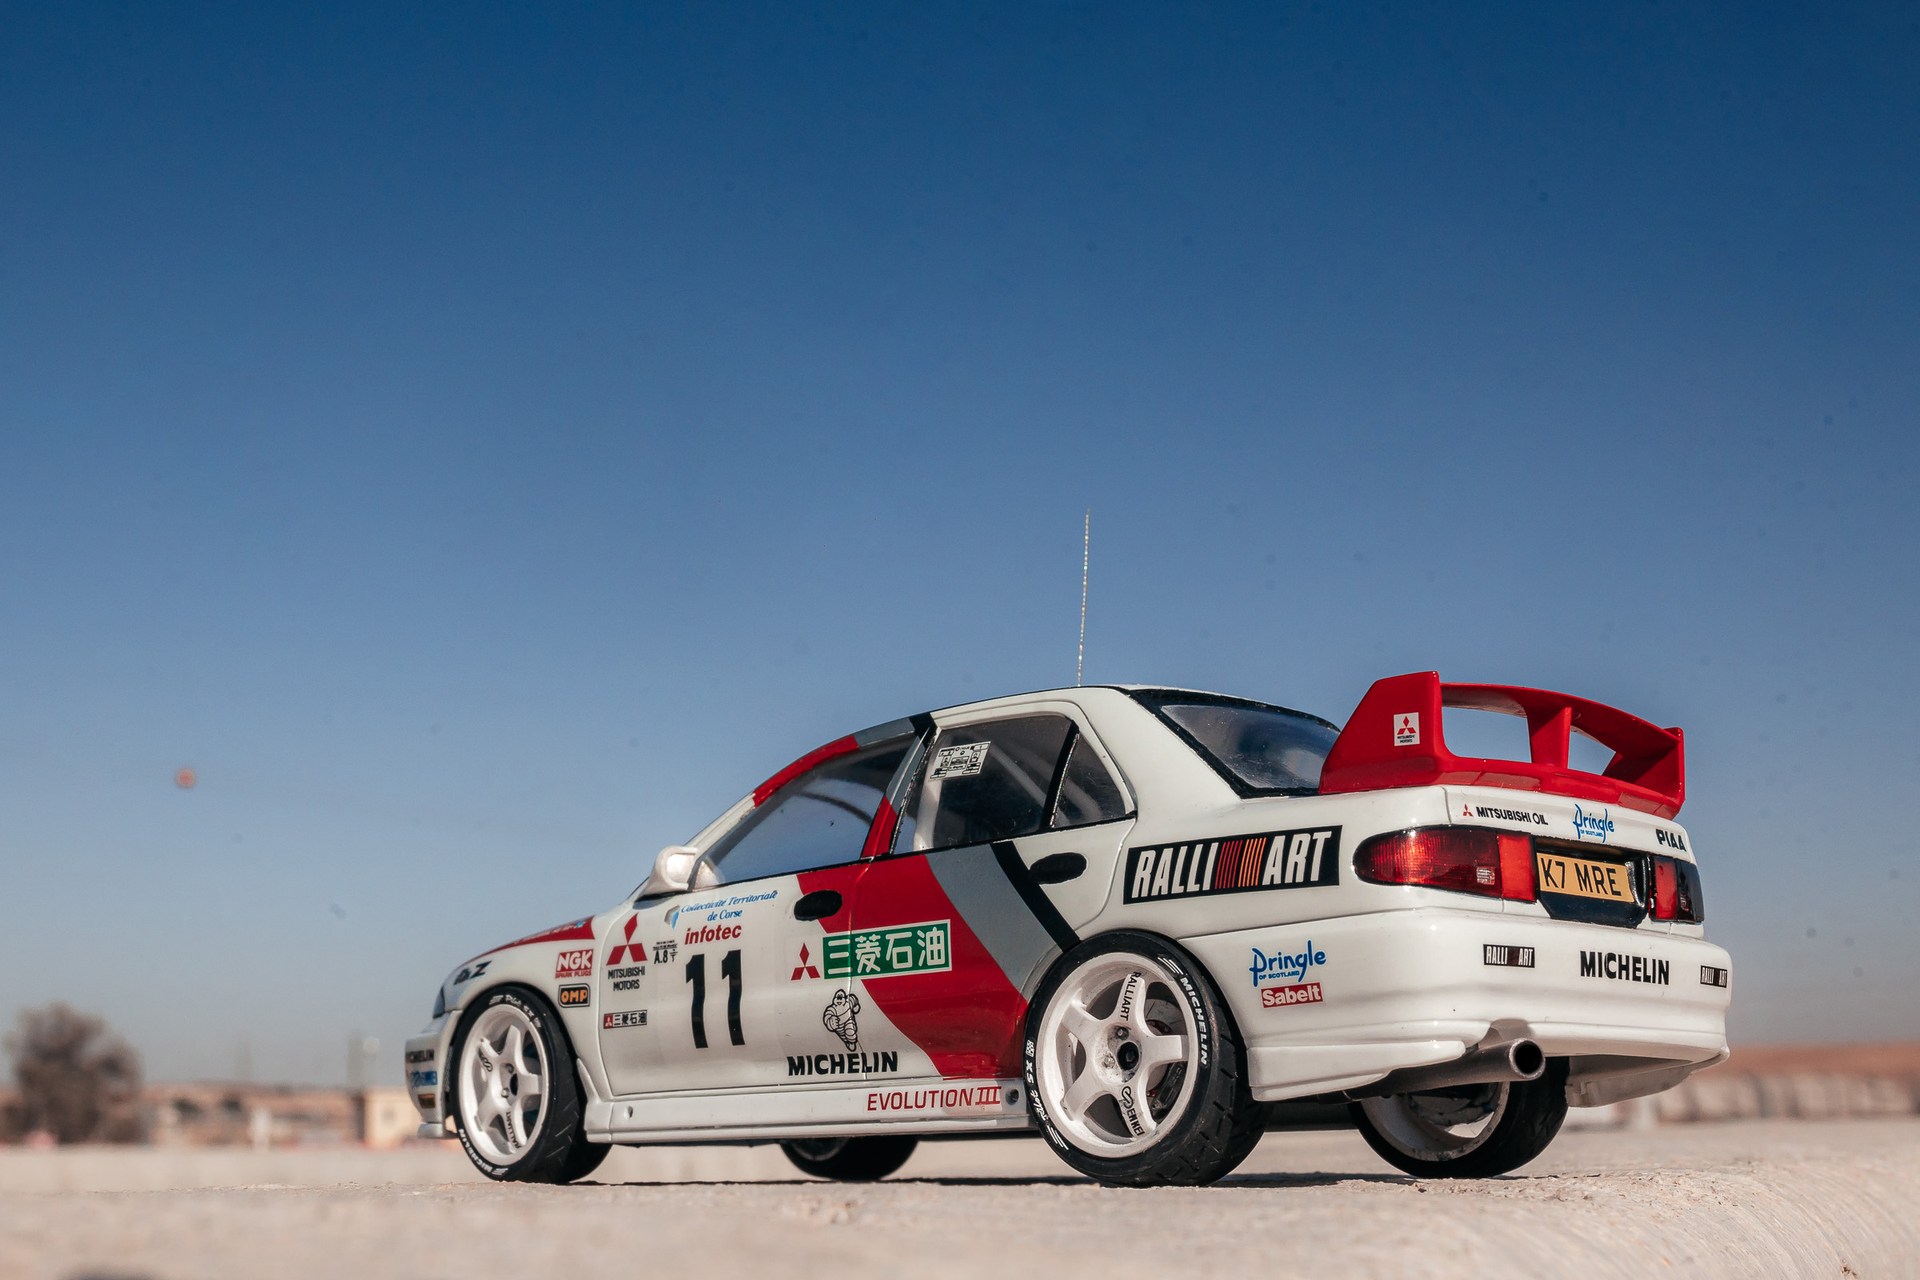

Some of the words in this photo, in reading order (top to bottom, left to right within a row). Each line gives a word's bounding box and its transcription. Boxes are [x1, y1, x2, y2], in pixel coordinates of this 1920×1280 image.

[1475, 806, 1531, 823] MITSUBISHI
[1532, 812, 1549, 826] OIL
[1572, 803, 1615, 844] Pringle
[1655, 828, 1688, 852] PIAA
[1540, 857, 1566, 889] K7
[1574, 861, 1623, 897] MRE
[707, 911, 718, 922] de
[719, 909, 743, 920] Corse
[684, 924, 742, 945] infotec
[556, 950, 593, 972] NGK
[653, 949, 669, 965] A.8
[827, 926, 946, 974] 三菱石油
[607, 966, 646, 980] MITSUBISHI
[1248, 939, 1327, 988] Pringle
[1268, 970, 1300, 980] SCOTLAND
[1580, 950, 1670, 986] MICHELIN
[560, 989, 588, 1003] OMP
[612, 979, 640, 992] MOTORS
[1119, 971, 1142, 1021] RALLIART
[1262, 984, 1322, 1007] Sabelt
[685, 948, 747, 1050] 11
[1180, 976, 1209, 1066] MICHELIN
[786, 1050, 898, 1077] MICHELIN
[867, 1087, 974, 1111] EVOLUTION
[1126, 1107, 1146, 1137] ENKEI
